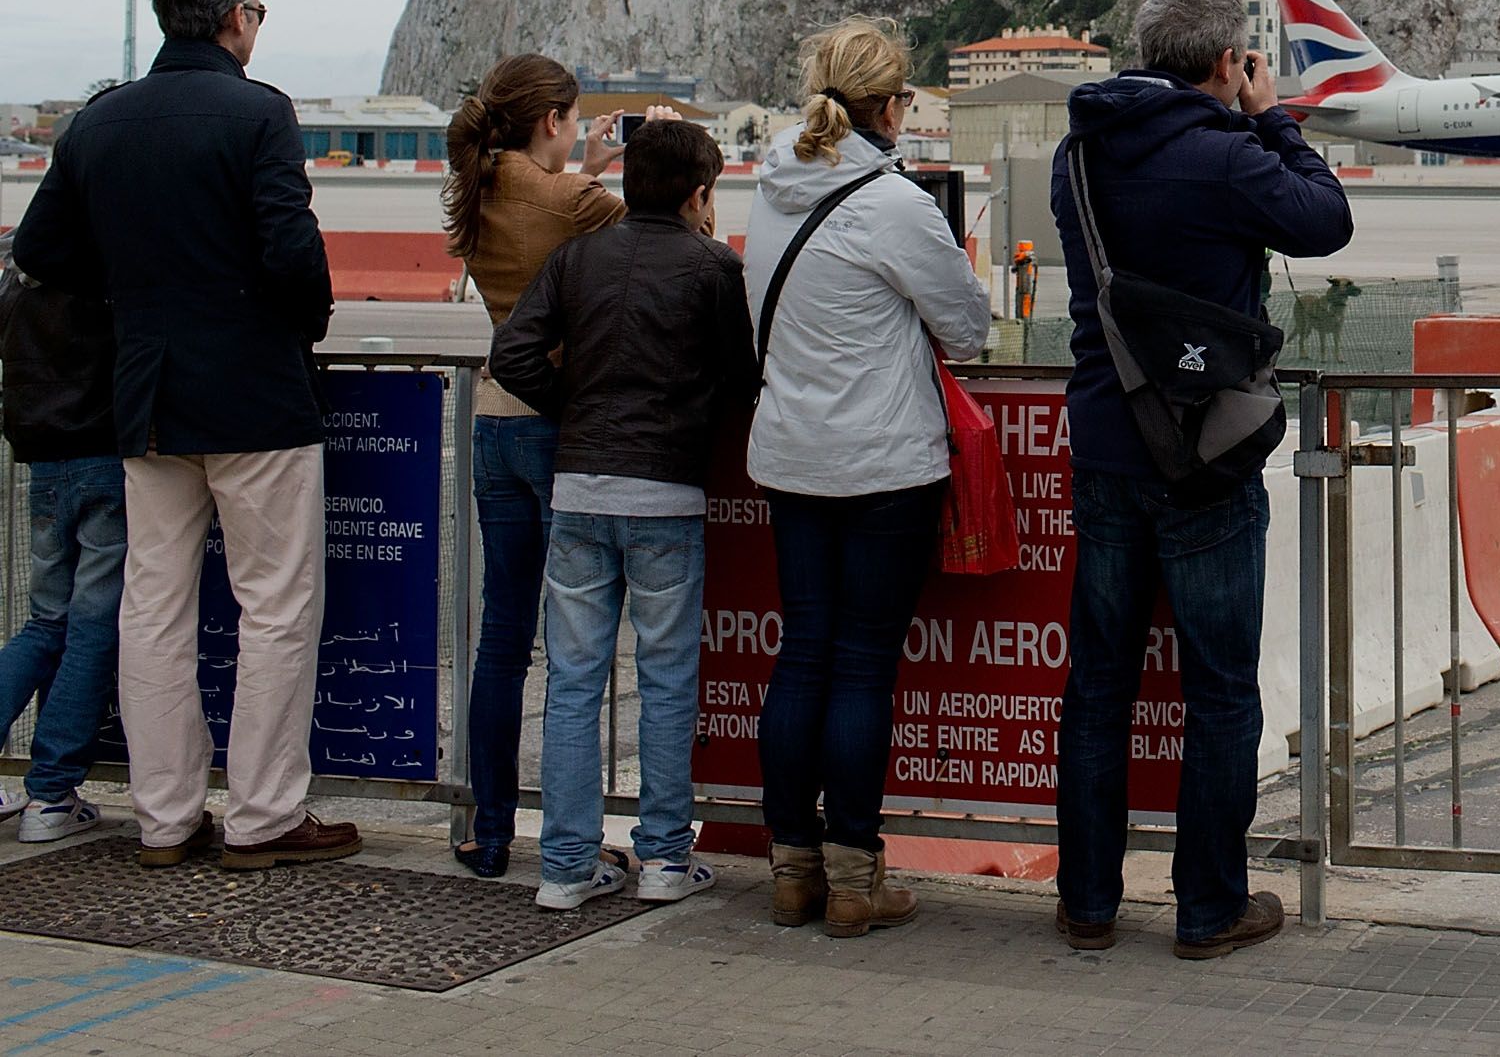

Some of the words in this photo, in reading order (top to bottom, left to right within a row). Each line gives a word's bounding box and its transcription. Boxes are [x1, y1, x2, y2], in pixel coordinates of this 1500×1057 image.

[1180, 360, 1204, 371] over
[322, 413, 381, 428] CCIDENT.
[1023, 472, 1062, 499] LIVE
[324, 496, 386, 514] SERVICIO.
[1037, 509, 1075, 535] THE
[356, 544, 373, 560] EN
[377, 546, 402, 561] ESE
[1018, 544, 1065, 571] CKLY
[700, 609, 783, 656] APRO
[706, 681, 750, 706] ESTA
[903, 691, 930, 715] UN
[938, 692, 1063, 723] AEROPUERTO
[937, 725, 999, 752] ENTRE
[1131, 735, 1184, 761] BLAN
[895, 756, 973, 784] CRUZEN
[981, 760, 1059, 789] RAPIDA
